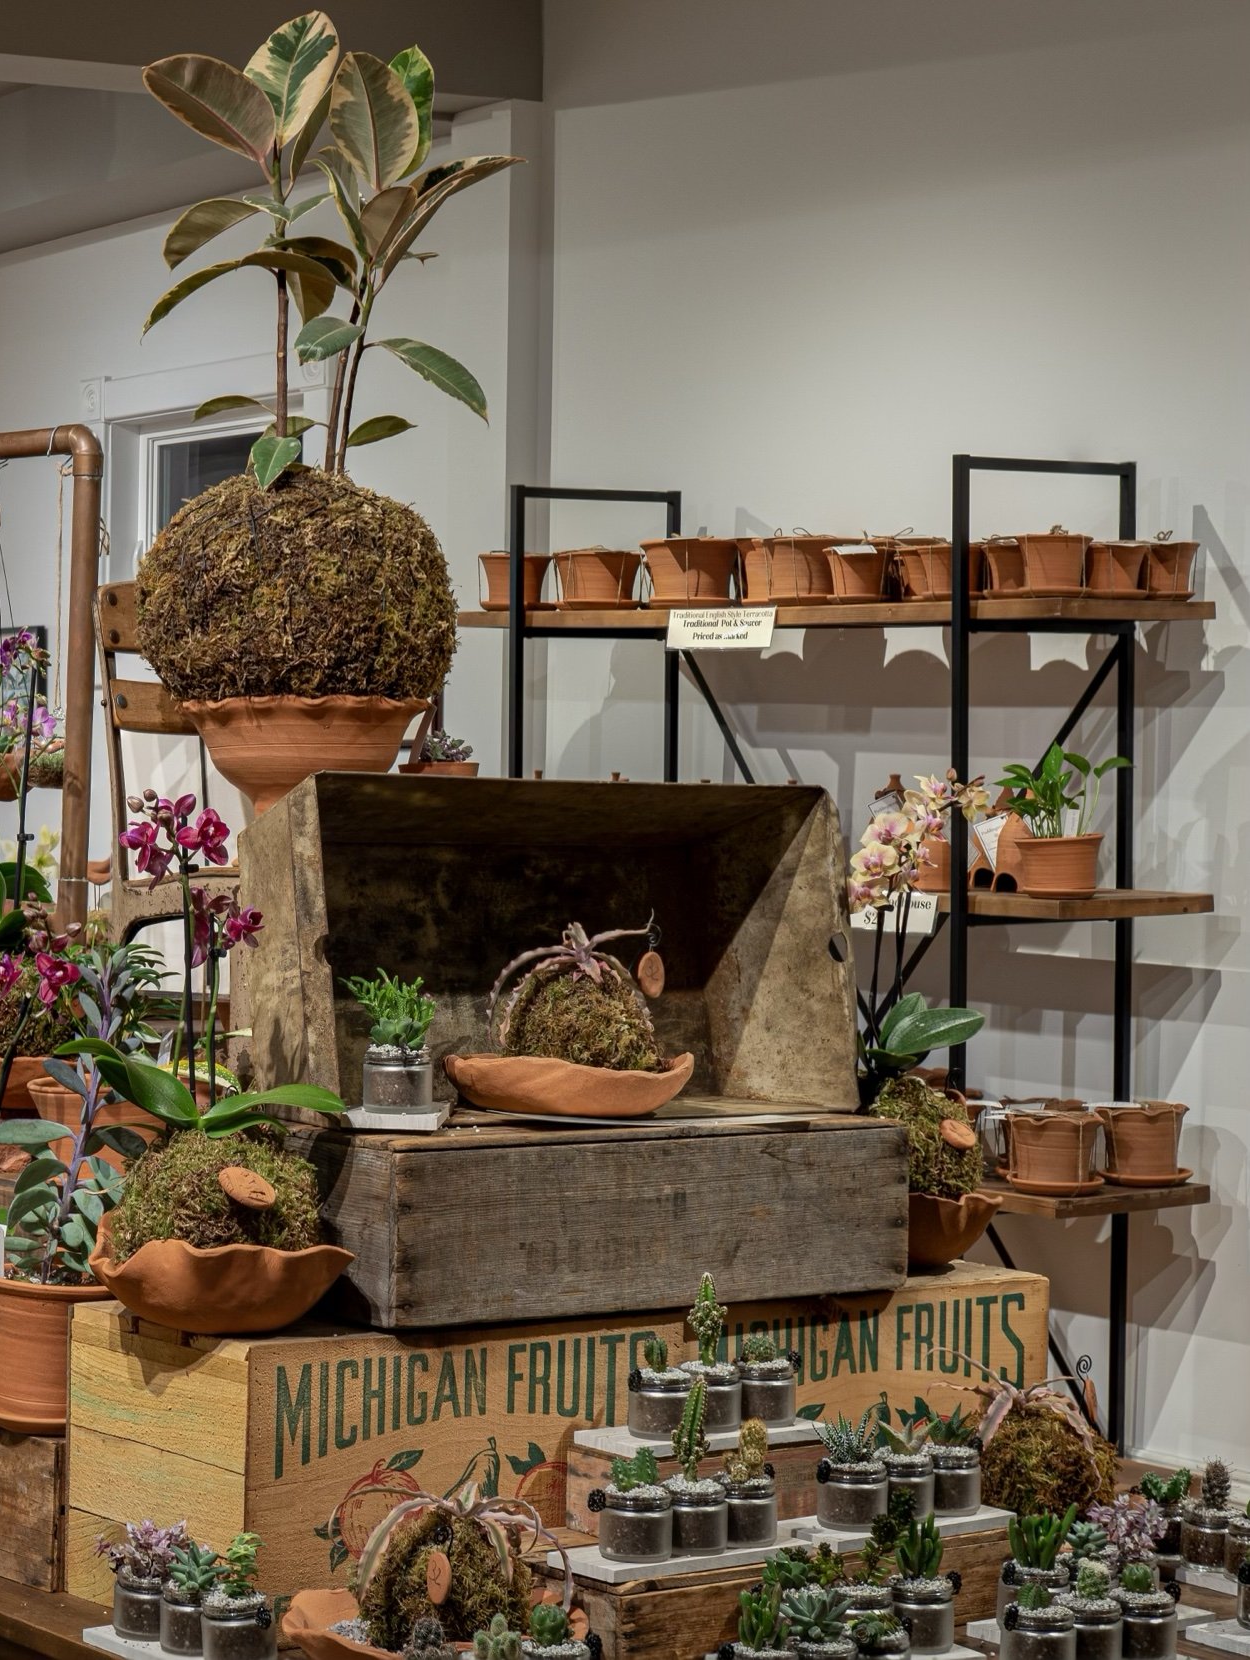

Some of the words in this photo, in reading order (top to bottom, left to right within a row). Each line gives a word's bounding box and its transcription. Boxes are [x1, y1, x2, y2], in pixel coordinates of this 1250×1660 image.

[683, 620, 719, 628] Traditional
[721, 619, 732, 627] Pot
[692, 632, 714, 640] Priced
[715, 632, 722, 640] as
[895, 1293, 1025, 1390] FRUITS
[275, 1347, 487, 1480] MICHIGAN
[507, 1331, 656, 1427] FRUIT
